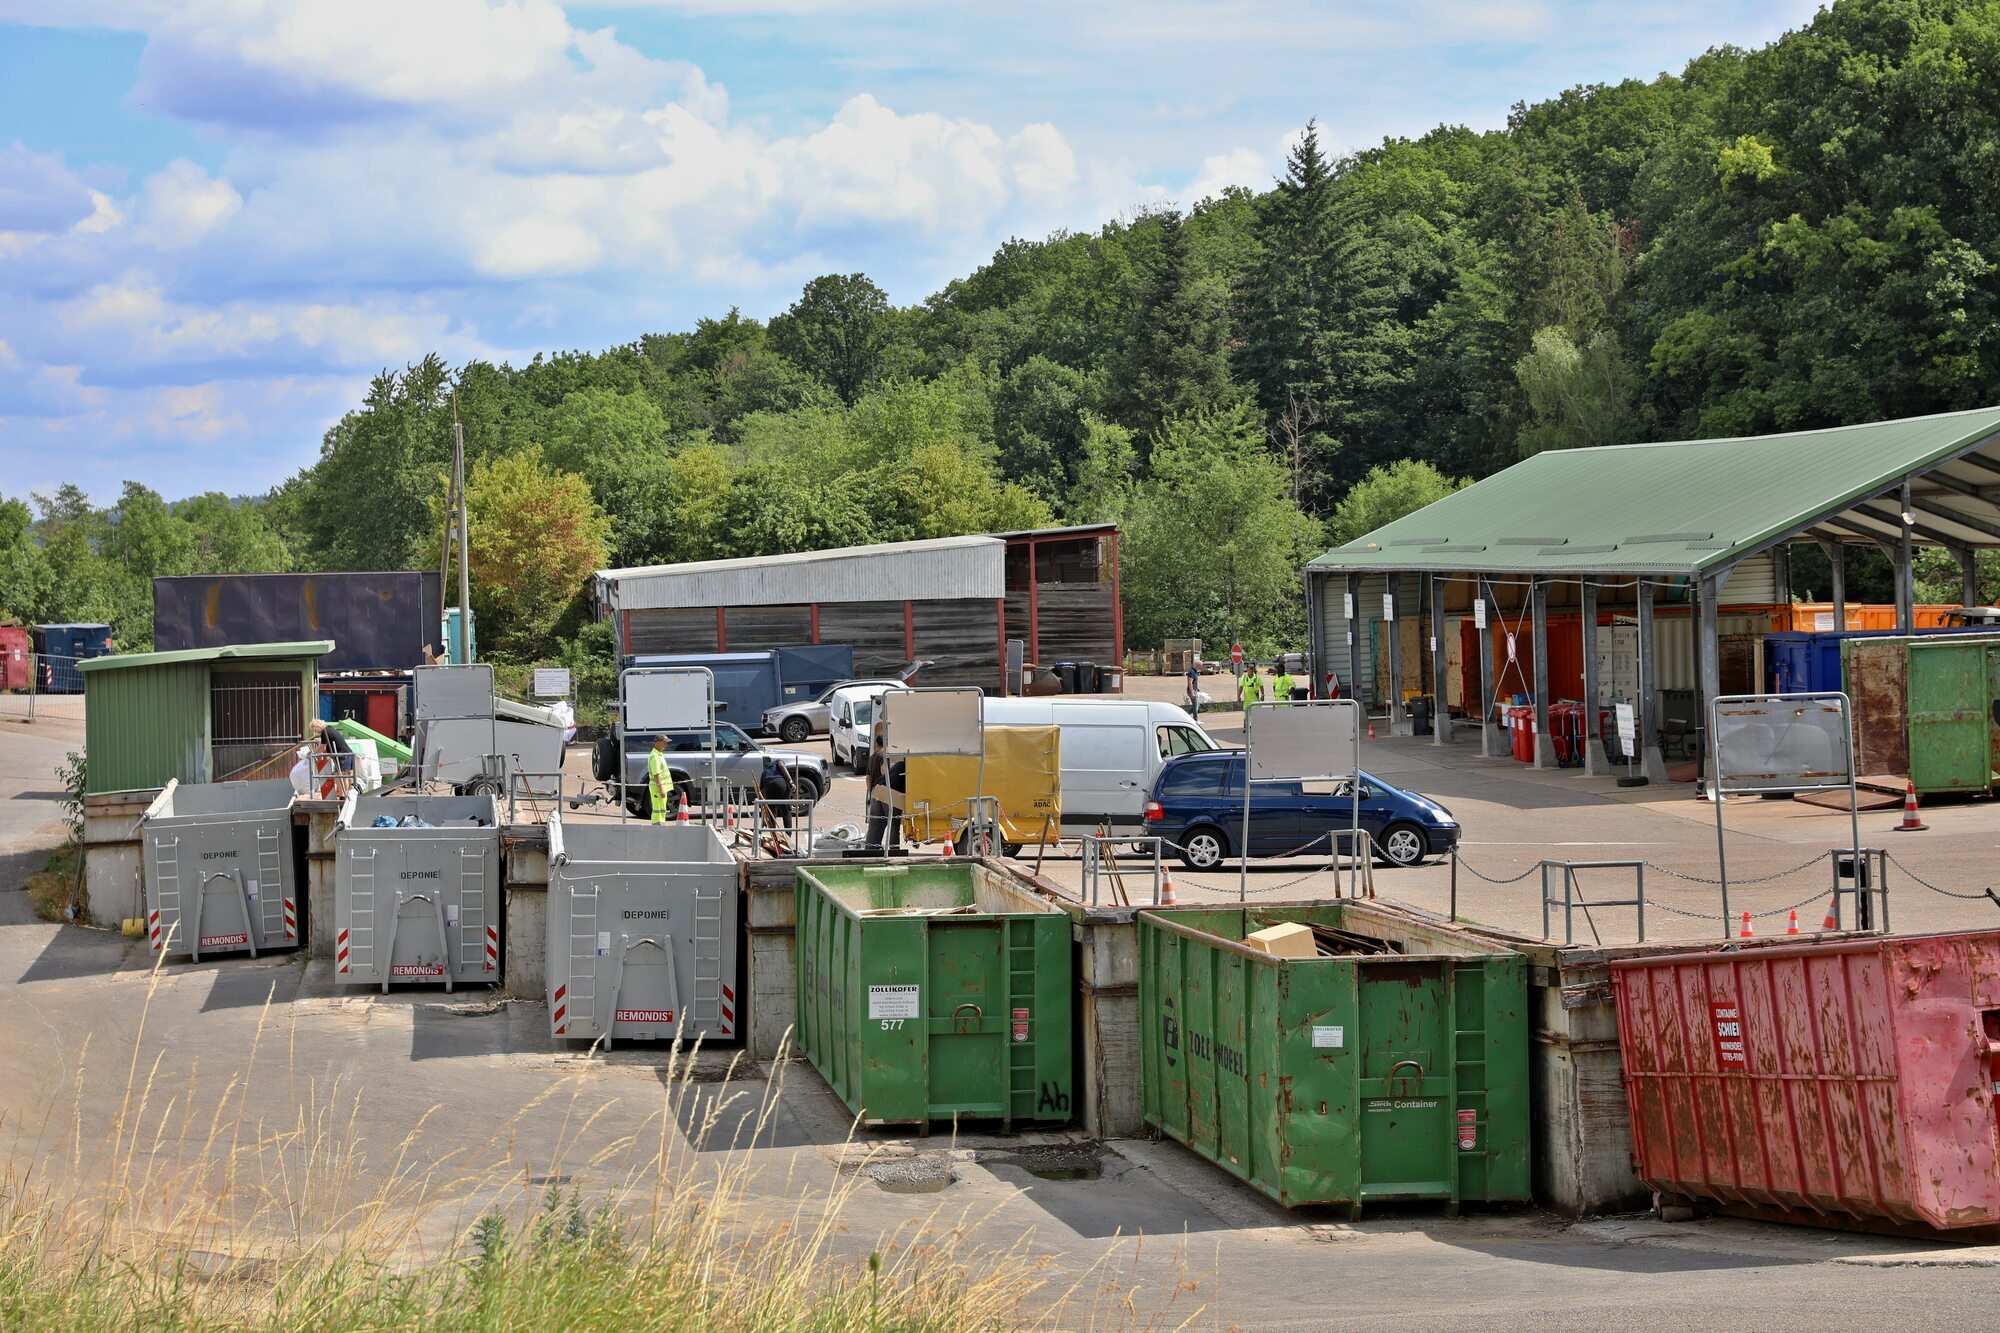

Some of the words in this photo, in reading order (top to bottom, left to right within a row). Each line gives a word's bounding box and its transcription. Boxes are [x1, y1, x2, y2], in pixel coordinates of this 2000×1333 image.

[343, 709, 356, 719] 71
[204, 850, 238, 860] DEPONIE
[400, 870, 439, 880] DEPONIE
[624, 910, 667, 920] DEPONIE
[202, 935, 243, 946] REMONDIS
[393, 966, 439, 975] REMONDIS
[616, 1010, 668, 1021] REMONDIS
[1716, 1008, 1738, 1018] CONTAINE
[881, 1019, 905, 1030] 577
[1394, 1100, 1438, 1109] Container
